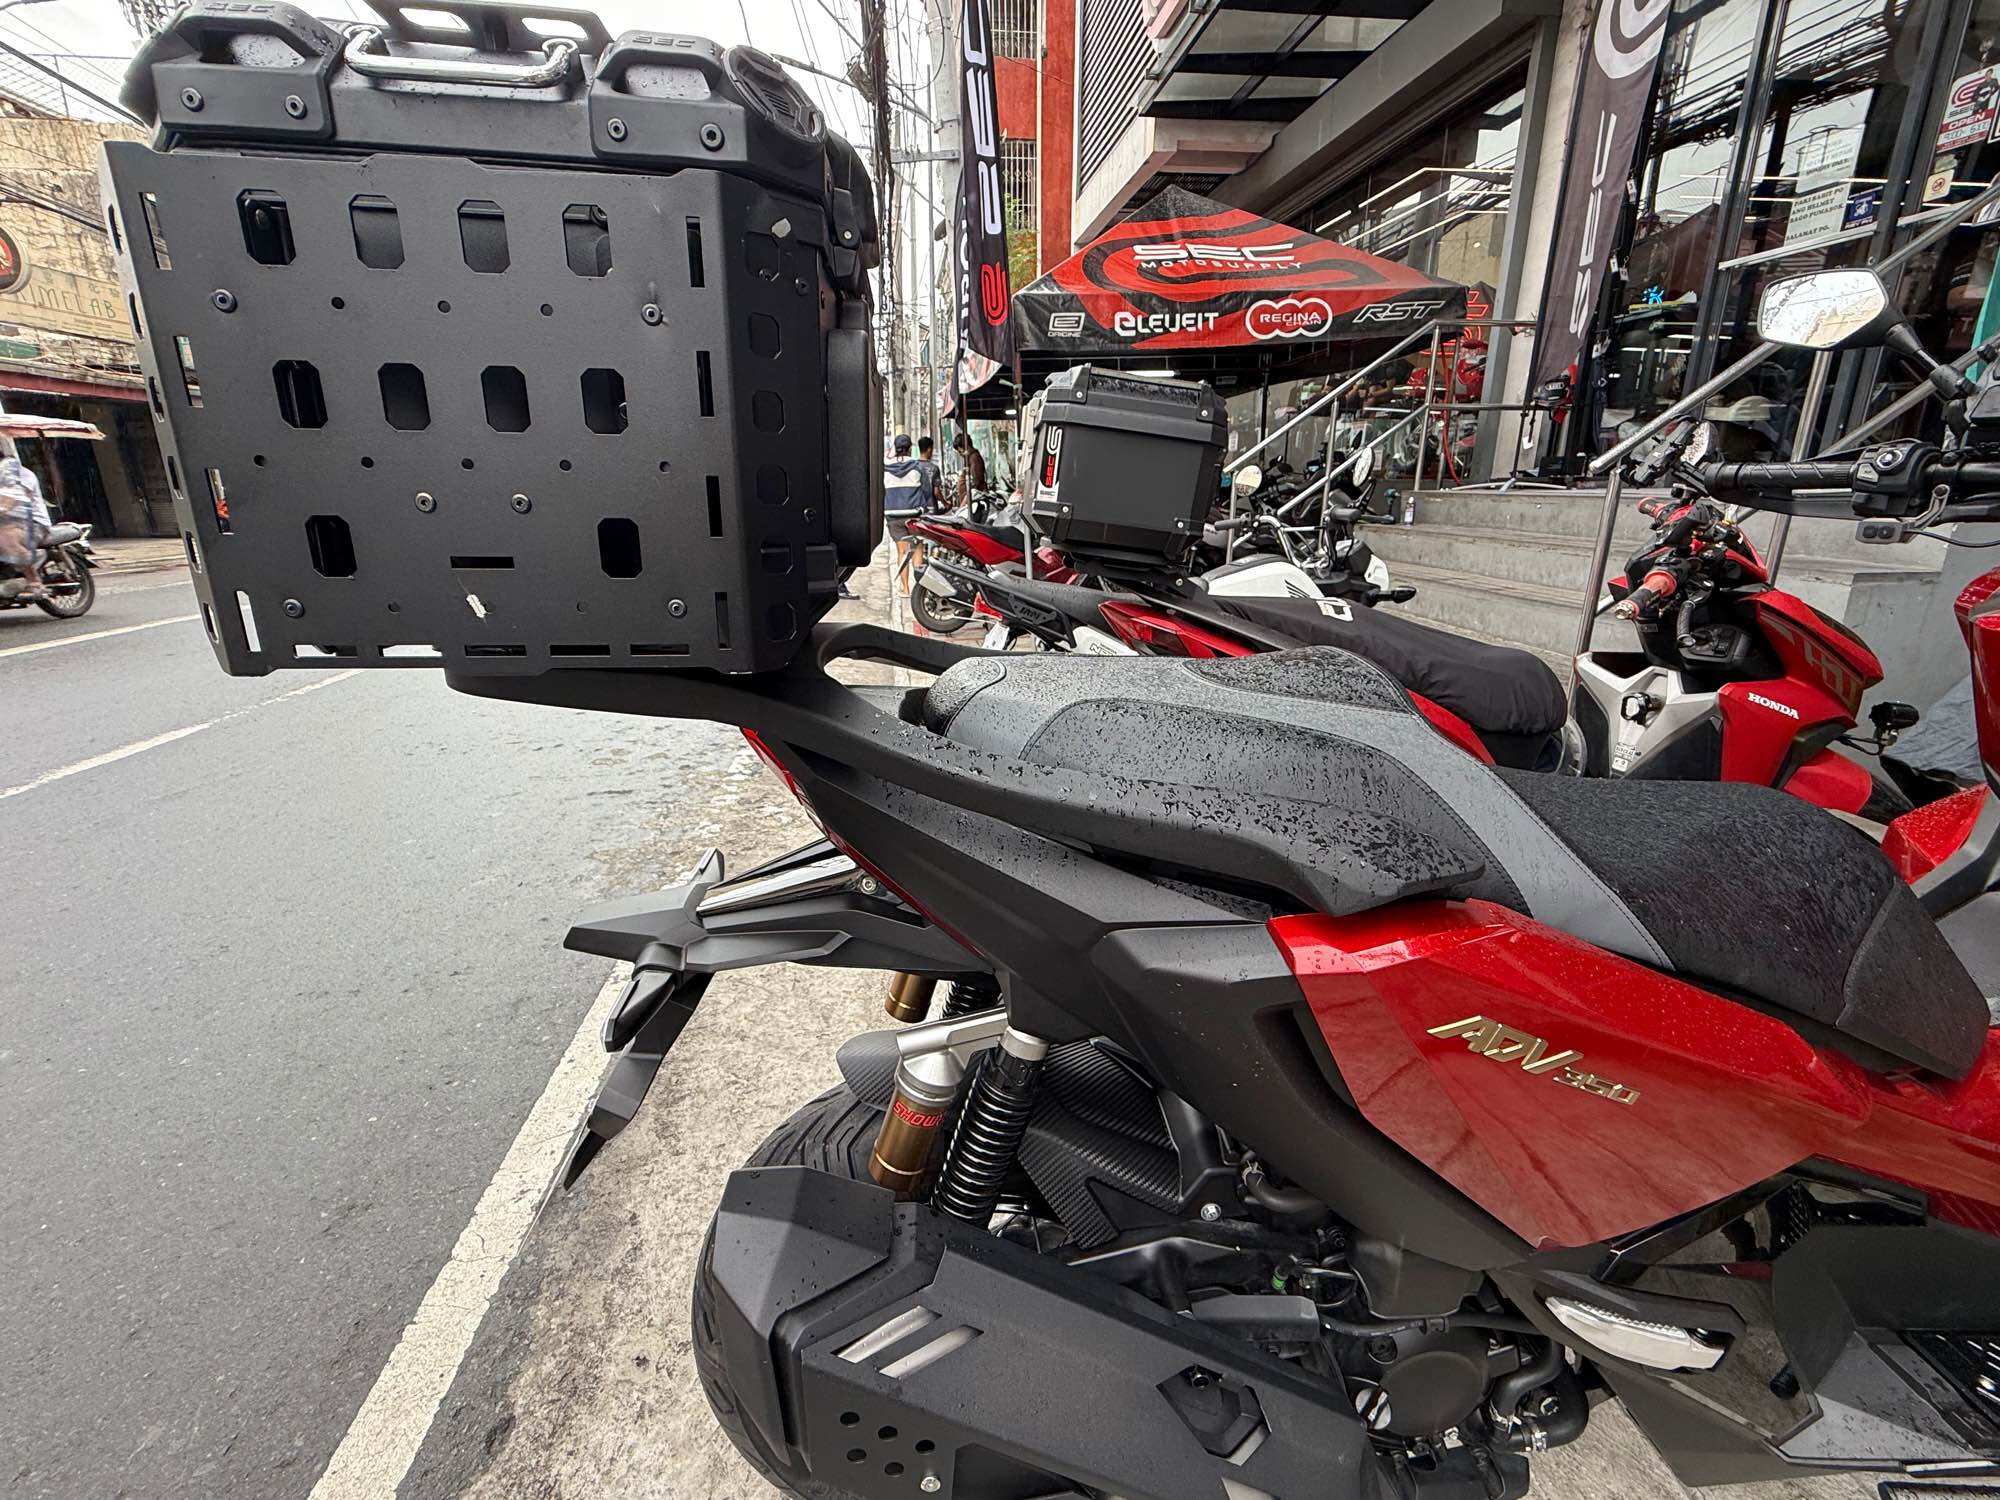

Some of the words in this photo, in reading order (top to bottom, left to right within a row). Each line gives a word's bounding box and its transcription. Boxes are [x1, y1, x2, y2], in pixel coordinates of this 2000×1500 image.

[1948, 110, 1985, 129] OPEN
[1807, 198, 1836, 211] HELMET
[1569, 109, 1618, 339] SEC
[1133, 243, 1294, 261] SEC
[1259, 311, 1321, 323] REGINA
[1352, 301, 1446, 323] RST
[1286, 318, 1322, 327] CHAIN
[1045, 455, 1056, 487] SEC
[1747, 692, 1800, 720] HONDA
[1426, 1015, 1584, 1075] ADV
[1552, 1065, 1641, 1106] 350
